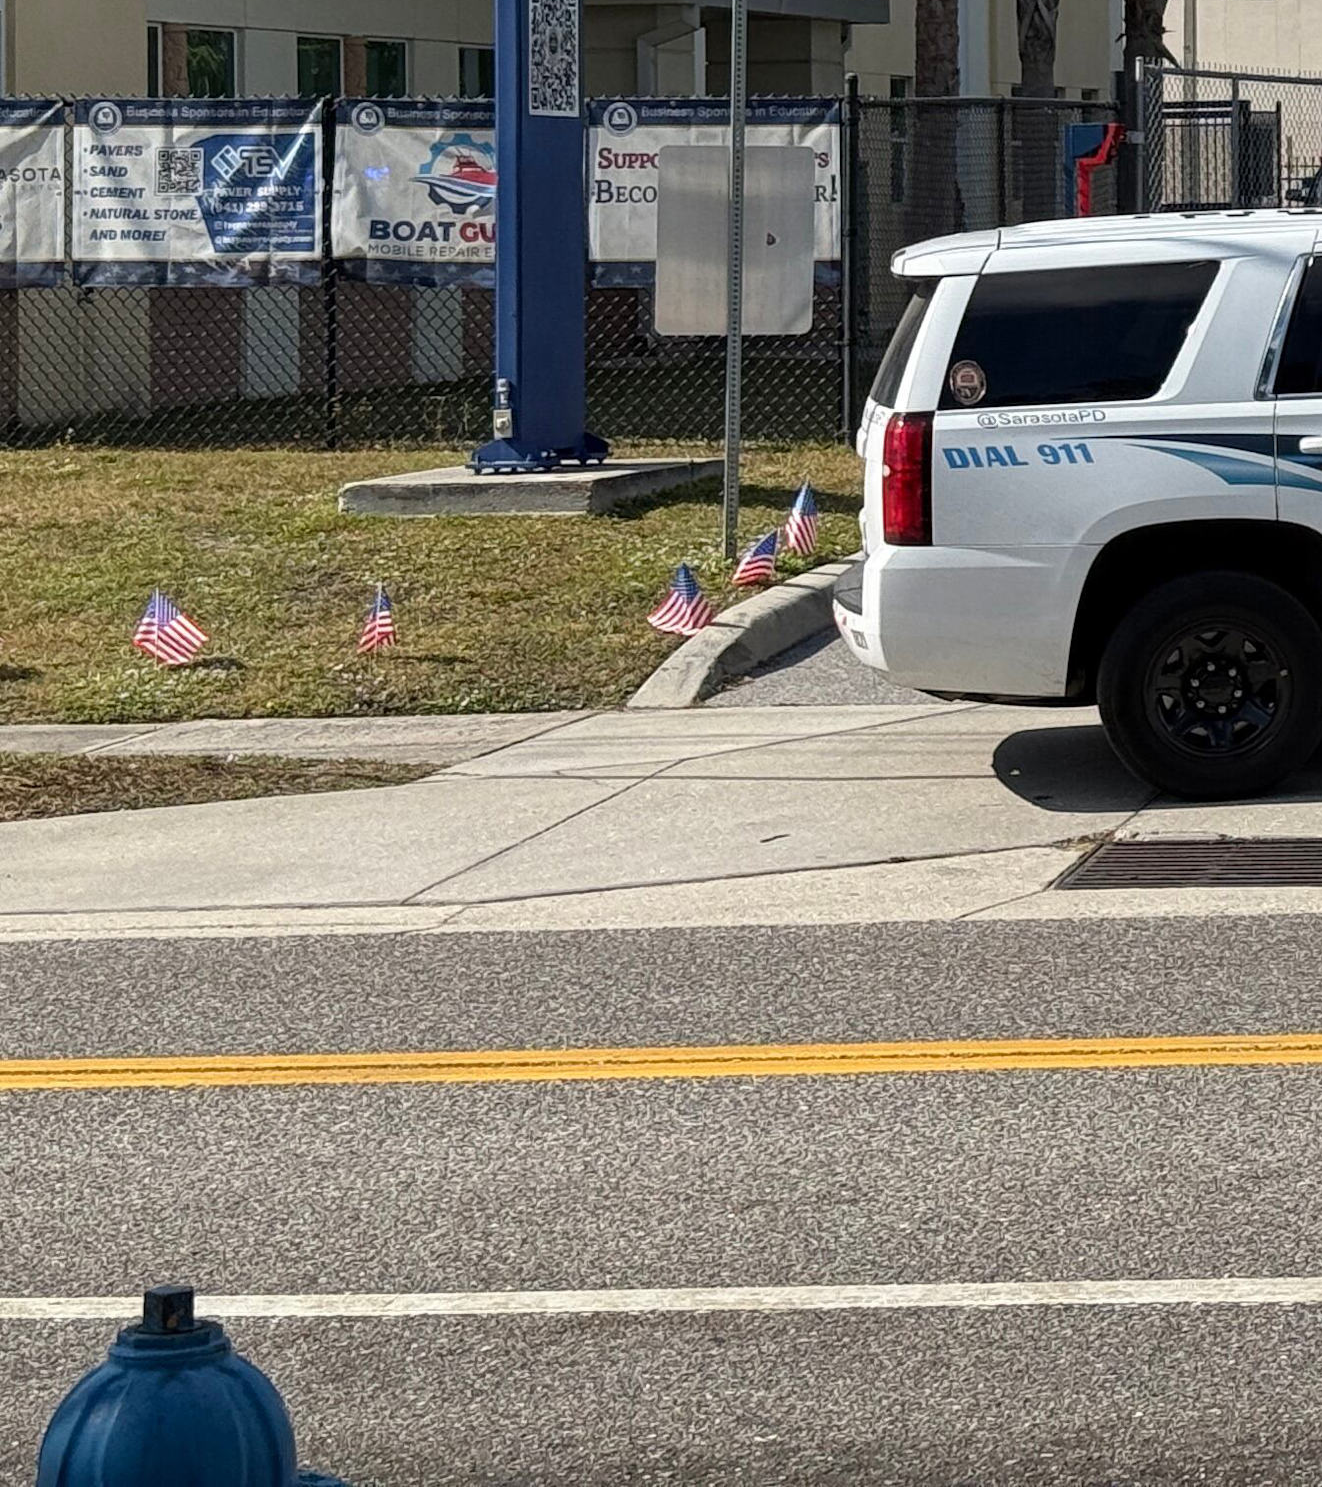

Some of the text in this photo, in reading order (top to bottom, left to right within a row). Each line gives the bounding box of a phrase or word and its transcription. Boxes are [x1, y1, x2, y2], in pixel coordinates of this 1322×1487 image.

[442, 108, 492, 122] Sponsor
[89, 144, 144, 157] PAVERS
[89, 165, 129, 178] SAND
[89, 186, 146, 199] CEMENT
[89, 207, 198, 221] NATURAL STONE
[90, 228, 167, 242] AND MORE!
[369, 219, 457, 242] BOAT
[368, 243, 425, 258] MOBILE
[429, 245, 481, 259] REPAIR
[977, 409, 1106, 430] @SarasotaPD
[942, 442, 1095, 470] DIAL 911
